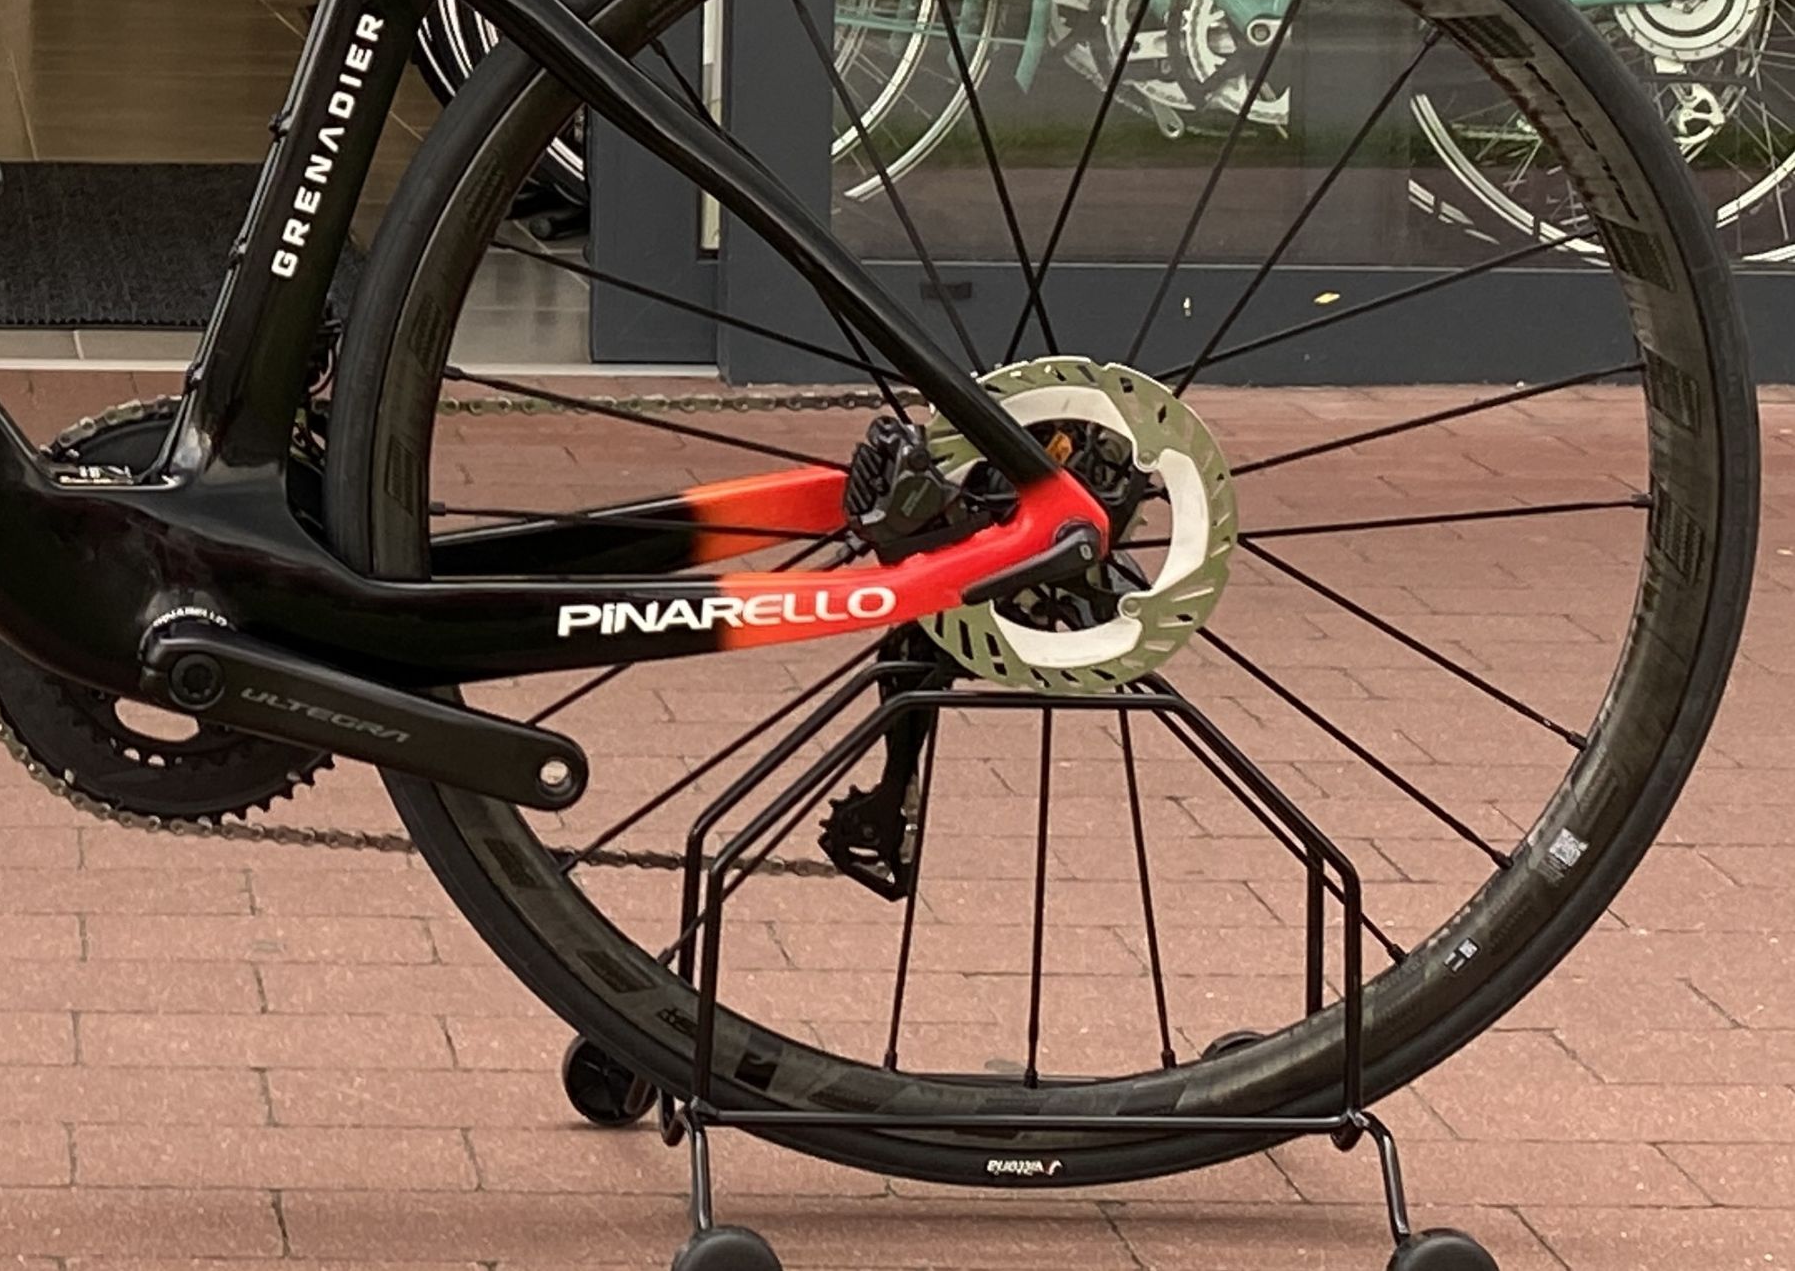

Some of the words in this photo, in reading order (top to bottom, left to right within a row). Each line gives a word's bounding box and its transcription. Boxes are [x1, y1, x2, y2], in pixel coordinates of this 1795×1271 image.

[271, 12, 386, 279] GRENADIER
[556, 585, 897, 638] PINARELLO
[241, 685, 412, 744] ULTEGRA
